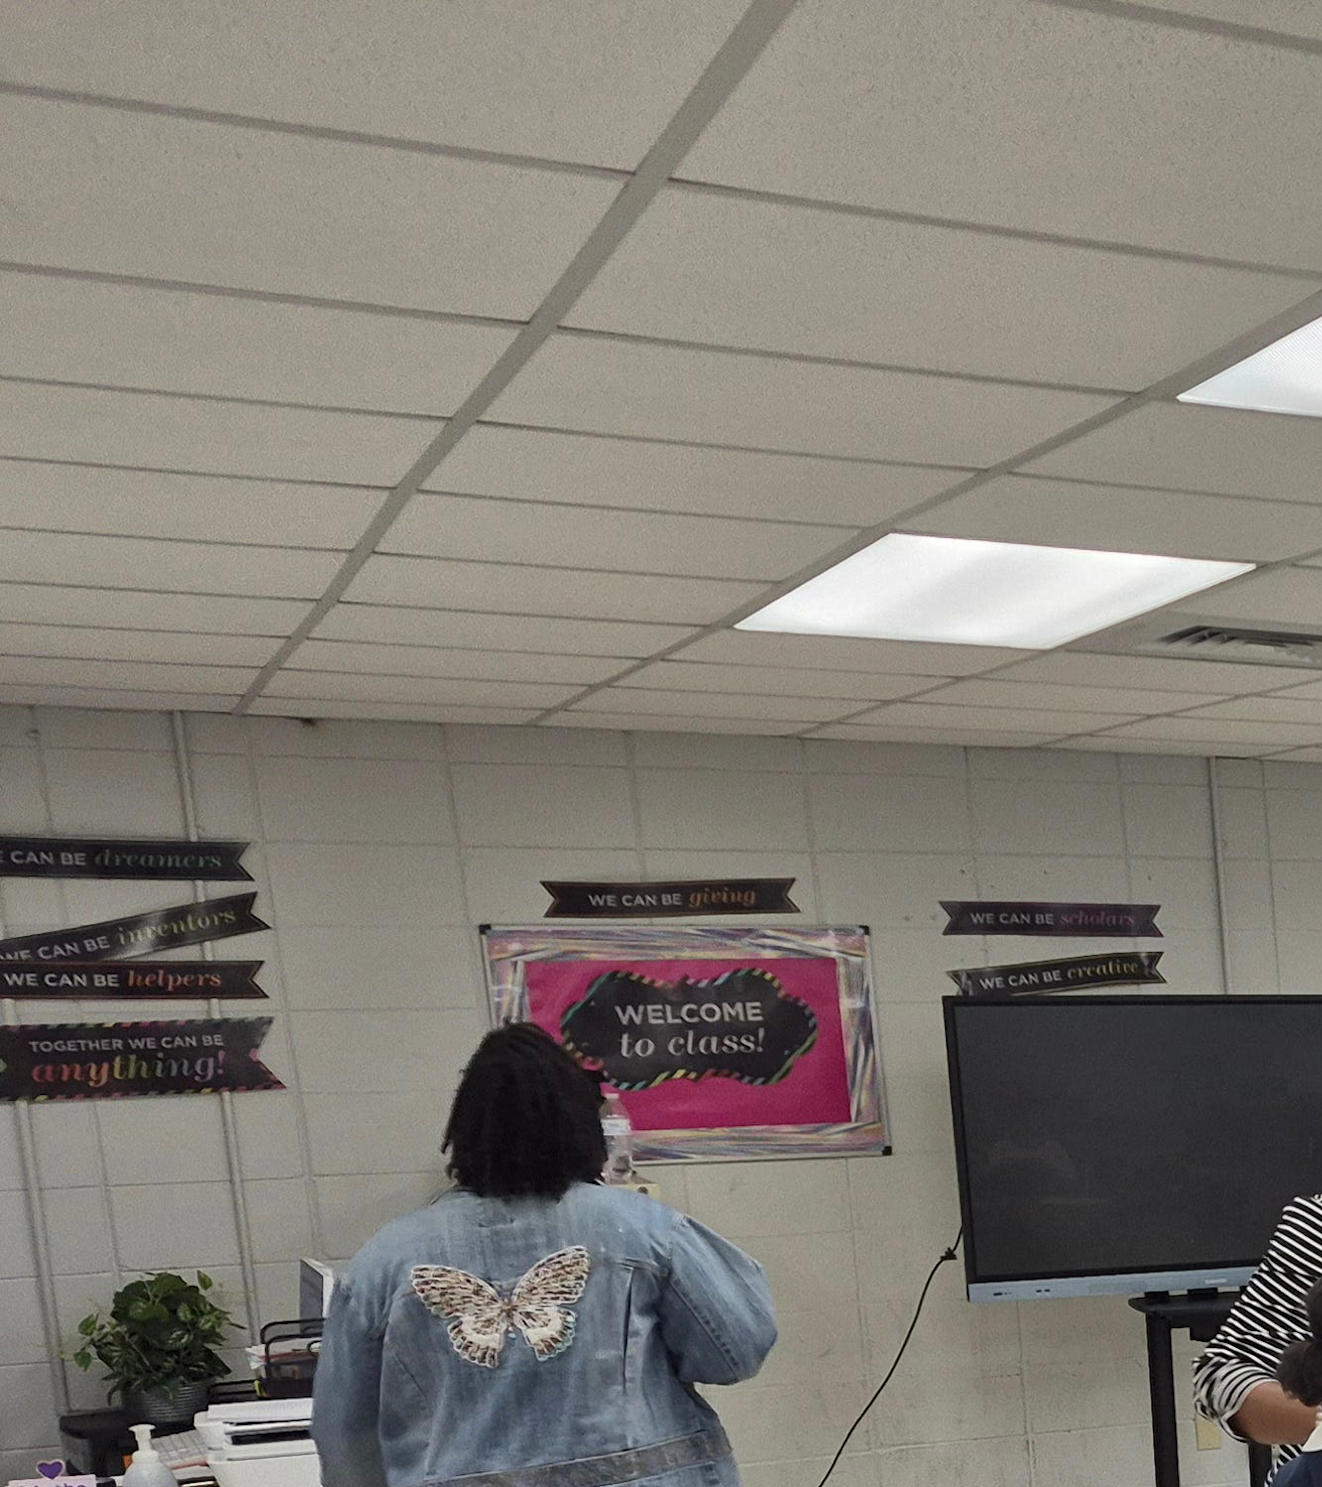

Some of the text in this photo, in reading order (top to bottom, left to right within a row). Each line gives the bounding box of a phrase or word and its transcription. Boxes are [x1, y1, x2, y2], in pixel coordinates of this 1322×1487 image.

[10, 851, 55, 865] CAN
[60, 853, 87, 866] BE
[94, 849, 222, 868] dreamers
[587, 886, 757, 908] WE CAN BE giving
[970, 909, 1136, 927] WE CAN BE scholars
[37, 942, 81, 960] CAN
[84, 936, 110, 952] BE
[116, 911, 236, 946] inventors
[4, 969, 222, 991] WE CAN BE helpers
[979, 959, 1139, 990] WE CAN BE creative
[614, 1002, 765, 1026] WELCOME
[28, 1034, 224, 1053] TOGETHER WE CAN BE
[619, 1028, 765, 1058] to class!
[31, 1051, 226, 1088] anything!
